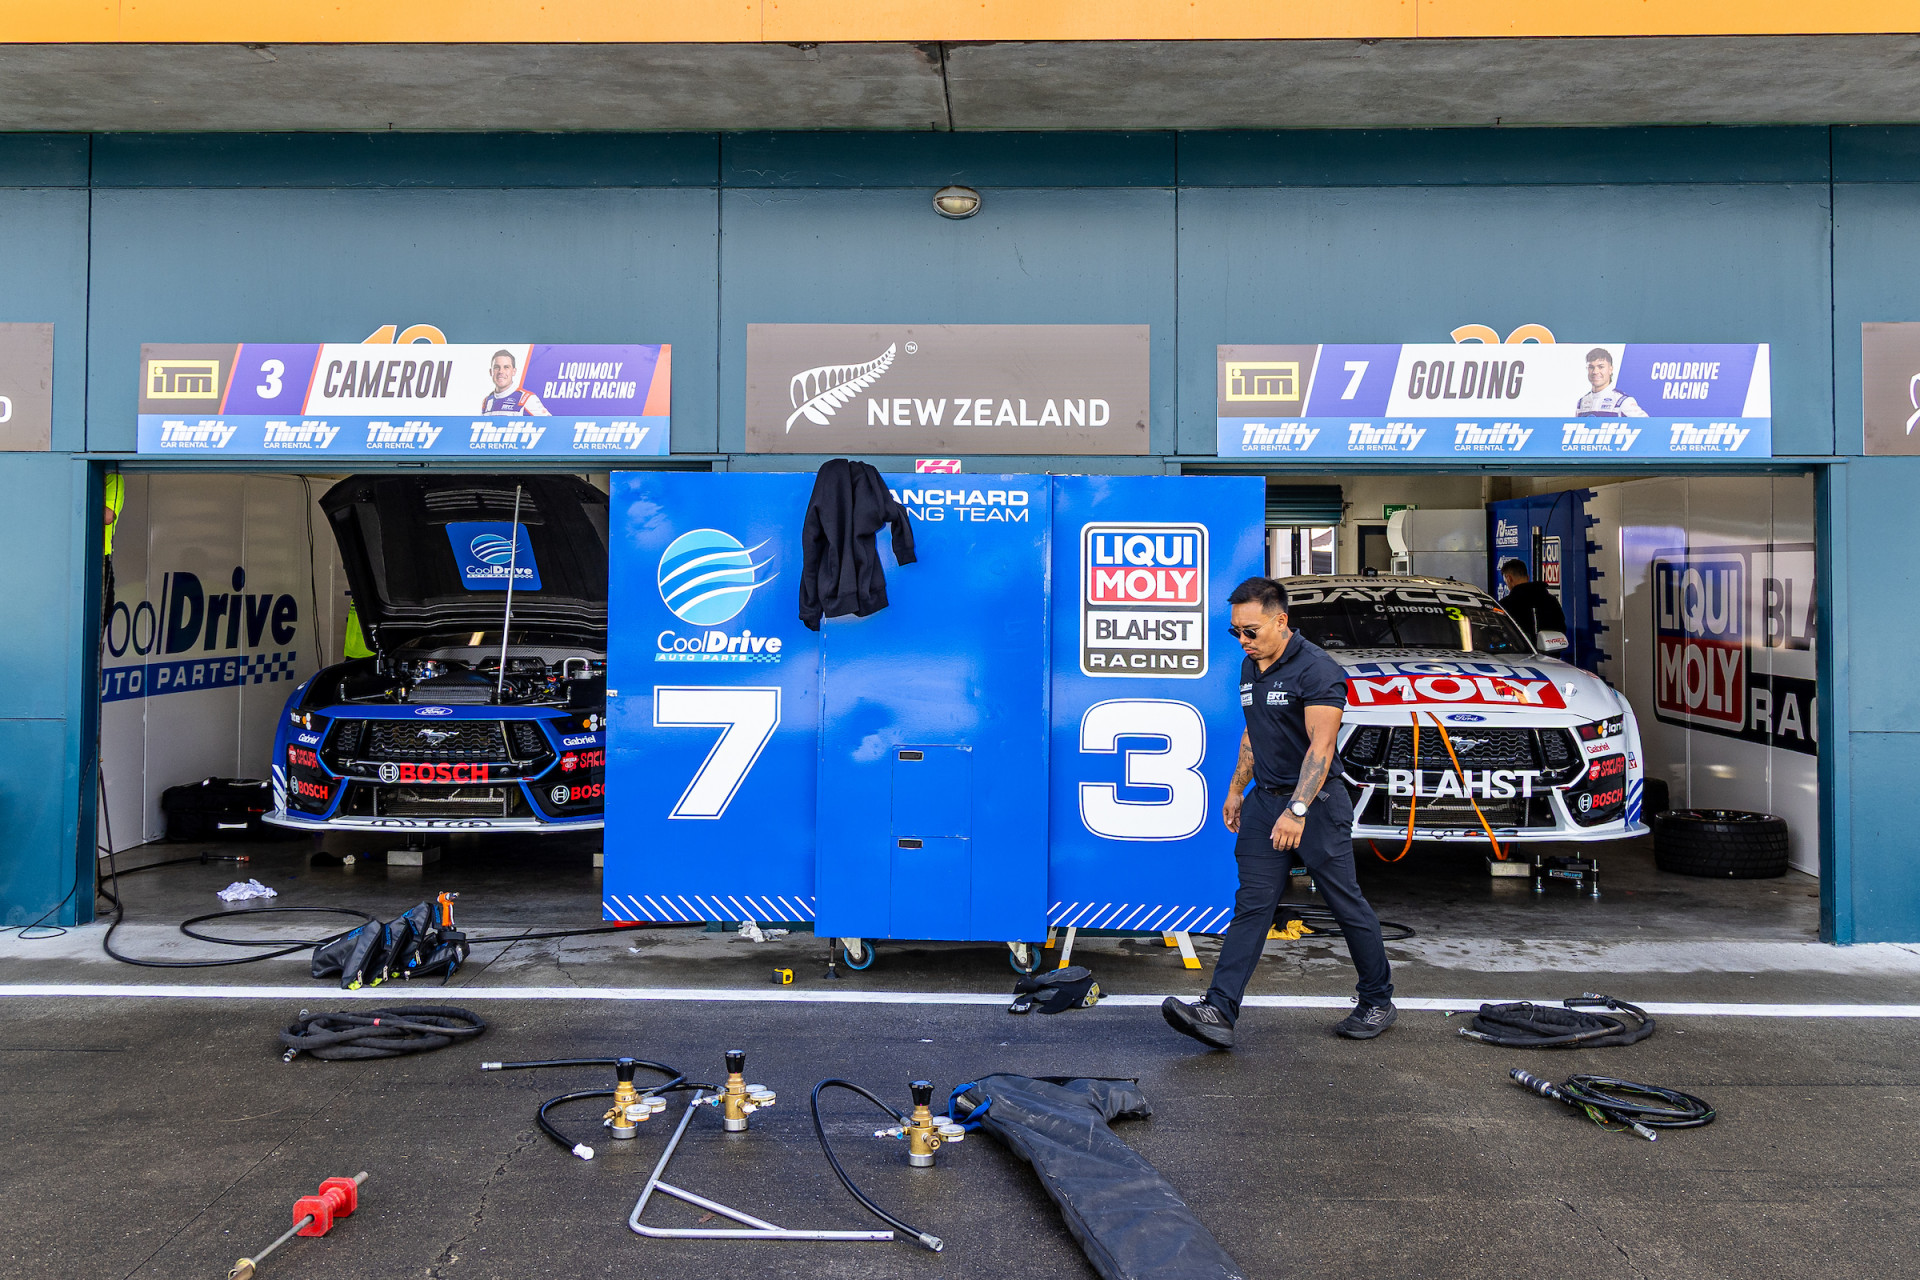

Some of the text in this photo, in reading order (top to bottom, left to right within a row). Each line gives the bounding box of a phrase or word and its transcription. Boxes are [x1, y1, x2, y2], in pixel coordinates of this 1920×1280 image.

[256, 359, 285, 399] 3
[322, 359, 453, 399] CAMERON
[557, 362, 623, 381] LIQUIMOLY
[1340, 360, 1370, 400] 7
[1407, 360, 1525, 400] GOLDING
[1651, 362, 1721, 380] COOLDRIVE
[543, 381, 636, 399] BLAHST RACING
[1662, 381, 1710, 400] RACING
[867, 398, 1110, 427] NEW ZEALAND
[160, 420, 238, 448] Thrifty
[263, 420, 341, 449] Thrifty
[366, 421, 444, 449] Thrifty
[469, 421, 547, 450] Thrifty
[572, 421, 650, 450] Thrifty
[1242, 423, 1321, 451] Thrifty
[1347, 423, 1427, 451] Thrifty
[1454, 423, 1534, 451] Thrifty
[1561, 423, 1642, 451] Thrifty
[1670, 423, 1751, 451] Thrifty
[888, 489, 1029, 506] ANCHARD
[954, 507, 1029, 522] TEAM
[1095, 534, 1193, 567] LIQUI
[466, 565, 533, 574] CoolDrve
[1095, 568, 1197, 600] MOLY
[1288, 587, 1482, 607] DAYCO
[103, 566, 298, 658] oolDrive
[1373, 603, 1444, 615] Cameron
[1445, 606, 1464, 621] 3
[1659, 568, 1738, 637] LIQUI
[1762, 578, 1816, 652] BLA
[657, 629, 782, 653] CoolDrive
[1095, 619, 1194, 641] BLAHST
[658, 654, 748, 662] AUTO PARTS
[1090, 653, 1199, 669] RACING
[1342, 662, 1538, 679] LIQUI
[157, 661, 236, 689] PARTS
[1661, 642, 1741, 714] MOLY
[1352, 676, 1550, 705] MOLY
[298, 733, 320, 744] Gabriel
[563, 734, 597, 746] Gabriel
[653, 685, 782, 820] 7
[1587, 742, 1610, 754] Gabriel
[400, 761, 489, 784] BOSCH
[580, 750, 606, 768] SAKU
[1079, 698, 1208, 842] 3
[1601, 756, 1625, 777] SAKURA
[298, 780, 329, 800] BOSCH
[570, 783, 605, 800] BOS
[1388, 768, 1541, 799] BLAHST
[1592, 787, 1623, 809] BOSCH
